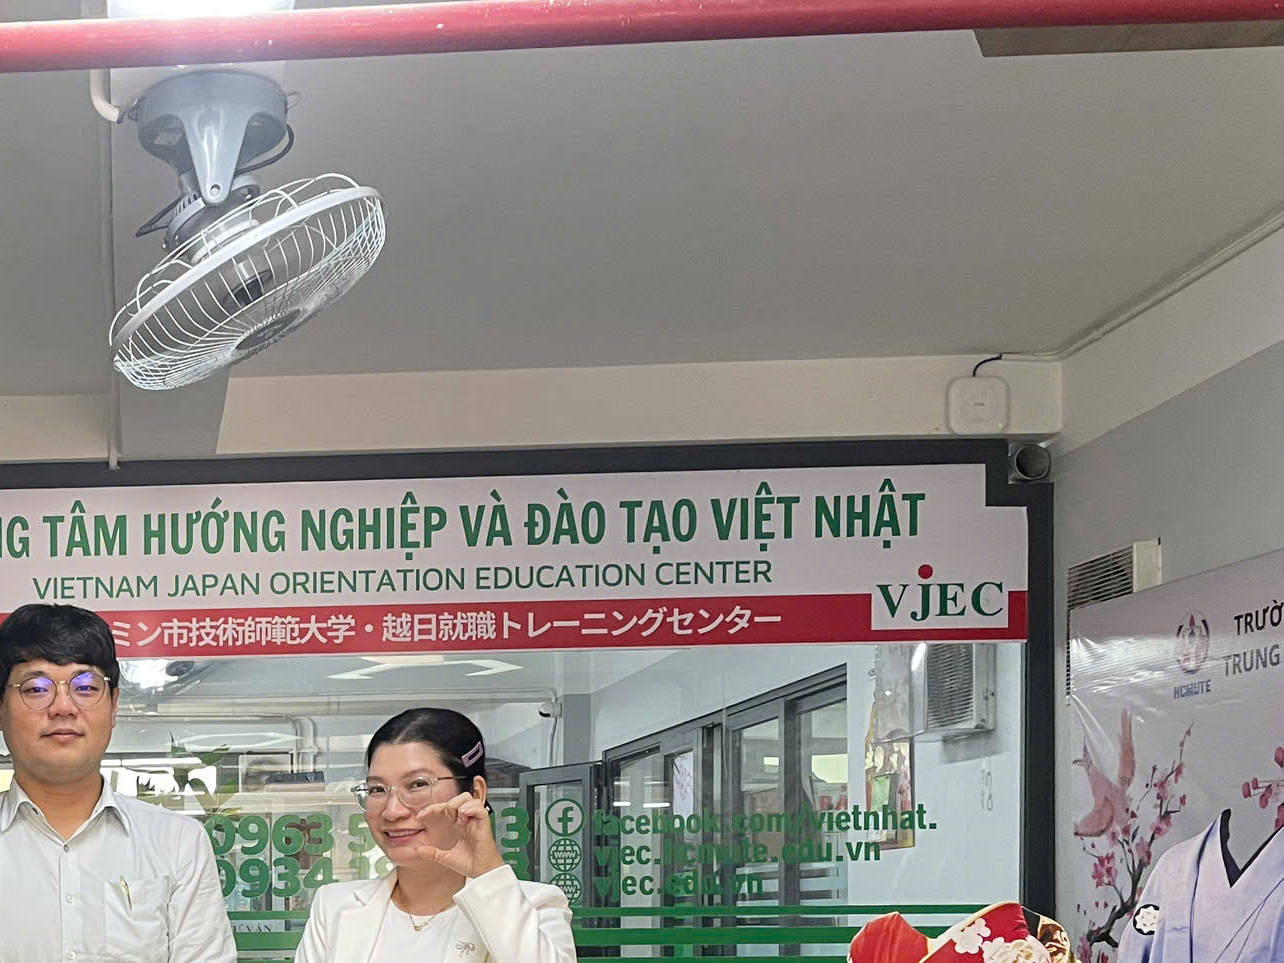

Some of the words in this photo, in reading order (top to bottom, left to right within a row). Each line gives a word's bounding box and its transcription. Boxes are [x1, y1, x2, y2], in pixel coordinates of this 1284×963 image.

[42, 500, 127, 558] TÂM
[143, 497, 285, 556] HƯỚNG
[301, 491, 447, 560] NGHIỆP
[460, 489, 512, 548] VÀ
[524, 487, 605, 546] ĐÀO
[619, 498, 697, 555] TẠO
[712, 481, 800, 552] VIỆT
[815, 478, 926, 548] NHẬT
[33, 575, 158, 600] VIETNAM
[168, 572, 260, 599] JAPAN
[269, 566, 465, 596] ORIENTATION
[476, 562, 645, 591] EDUCATION
[655, 560, 772, 586] CENTER
[1222, 644, 1280, 677] TRUNG
[1173, 679, 1212, 700] HCMUTE
